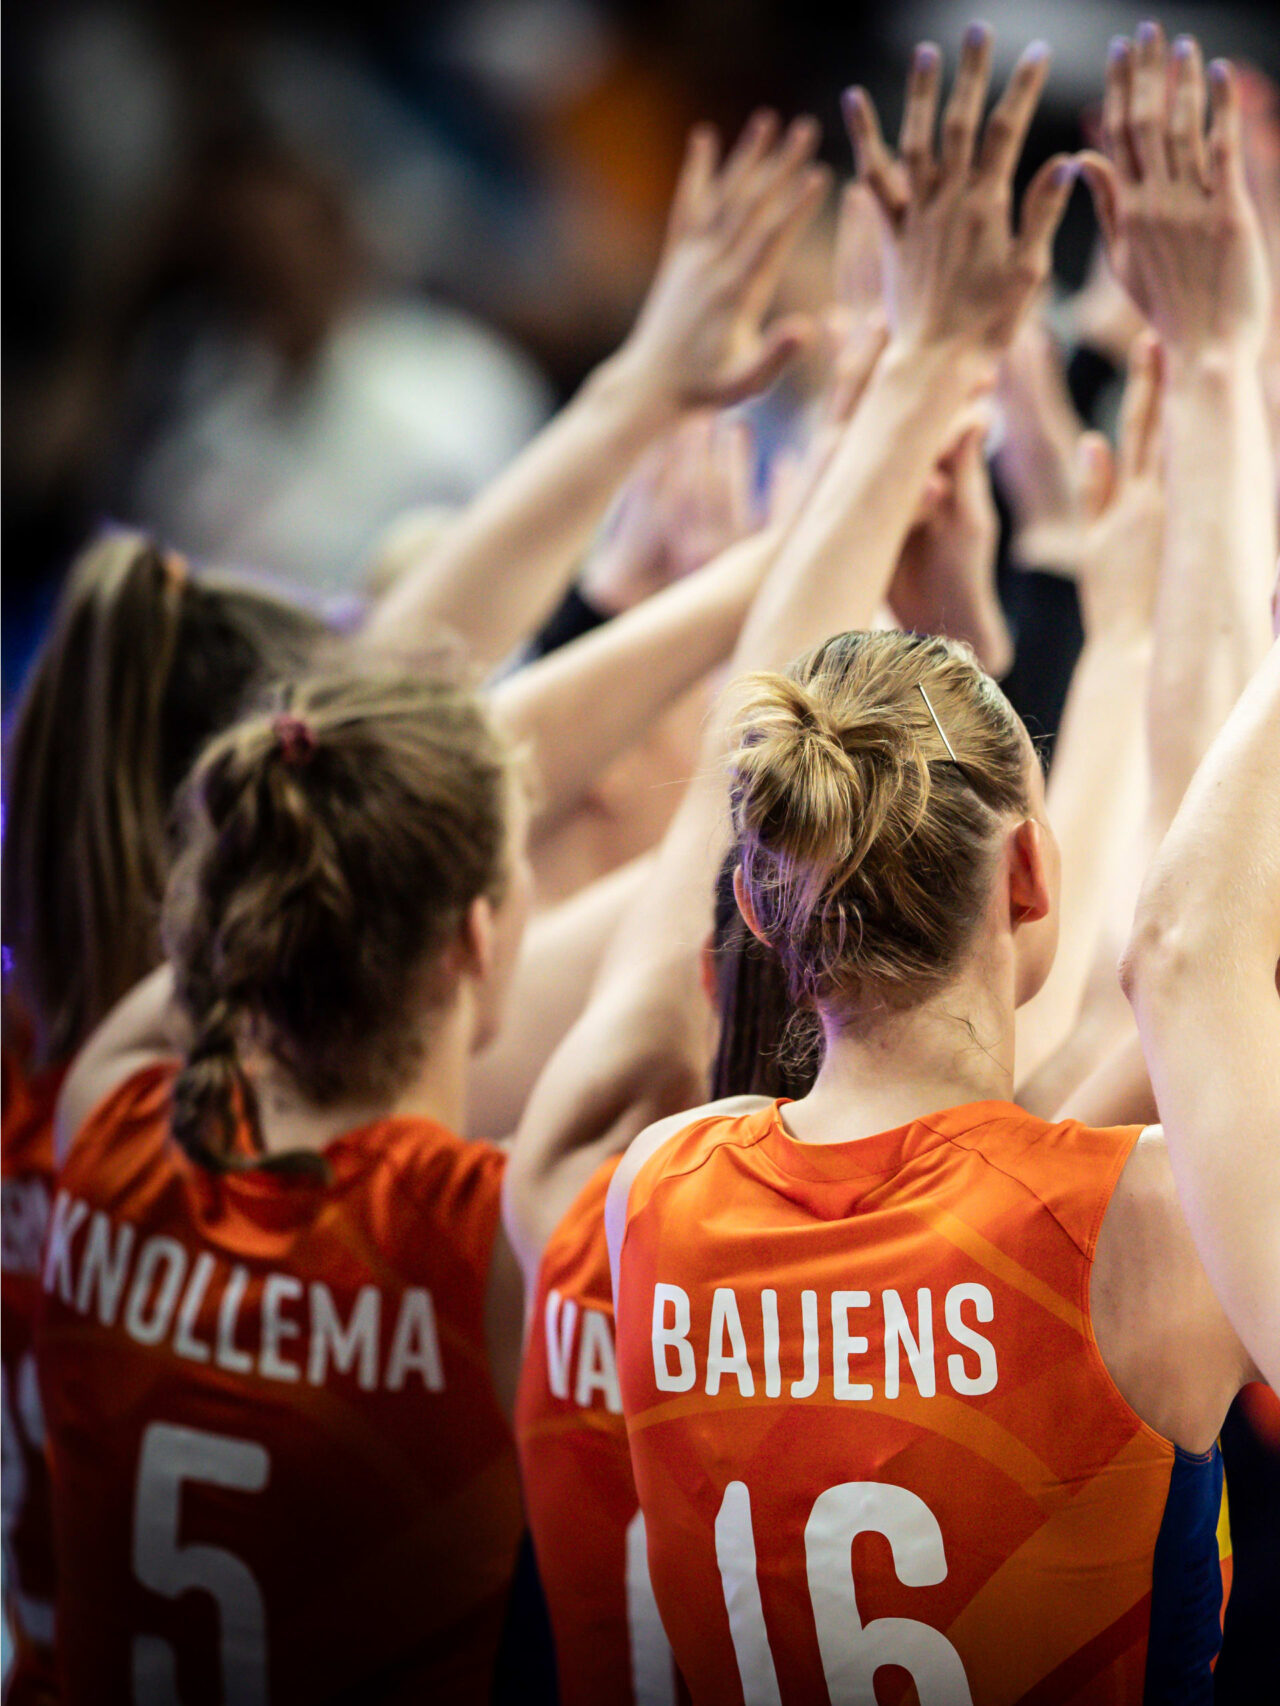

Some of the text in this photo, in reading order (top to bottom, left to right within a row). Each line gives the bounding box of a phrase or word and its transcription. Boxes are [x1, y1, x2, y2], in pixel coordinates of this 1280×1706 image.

[42, 1190, 445, 1392] KNOLLEMA
[651, 1282, 998, 1400] BAIJENS
[129, 1419, 272, 1706] 5
[715, 1480, 973, 1706] 16
